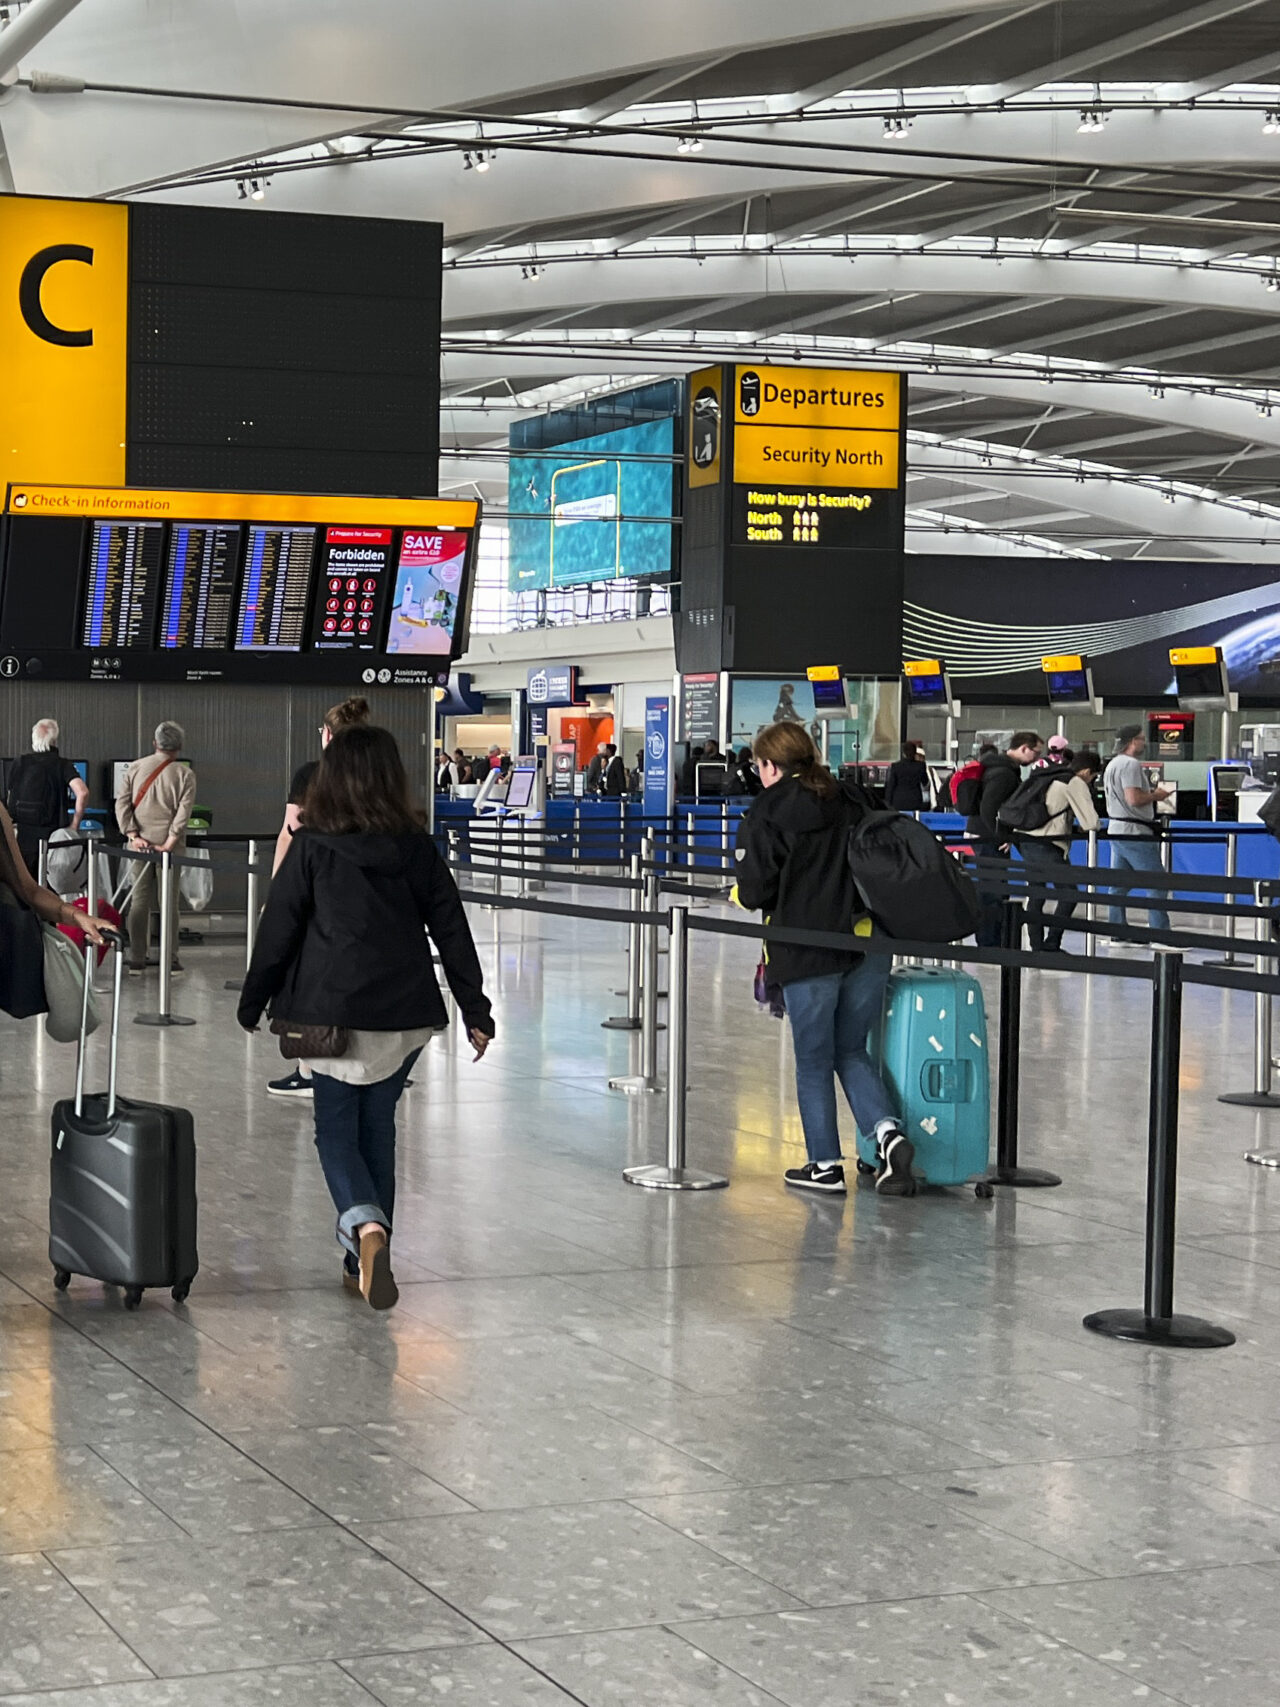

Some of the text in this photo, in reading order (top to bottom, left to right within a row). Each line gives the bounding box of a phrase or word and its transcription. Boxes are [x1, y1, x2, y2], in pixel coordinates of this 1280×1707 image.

[18, 243, 94, 347] C
[763, 383, 885, 409] Departures
[763, 446, 883, 467] Security North
[31, 494, 170, 510] Check-in information
[747, 491, 776, 505] How
[777, 492, 806, 509] busy
[818, 493, 872, 511] Security?
[747, 511, 783, 525] North
[747, 526, 783, 541] South
[404, 535, 443, 550] SAVE
[329, 548, 385, 560] Forbidden
[394, 668, 428, 676] Assistance
